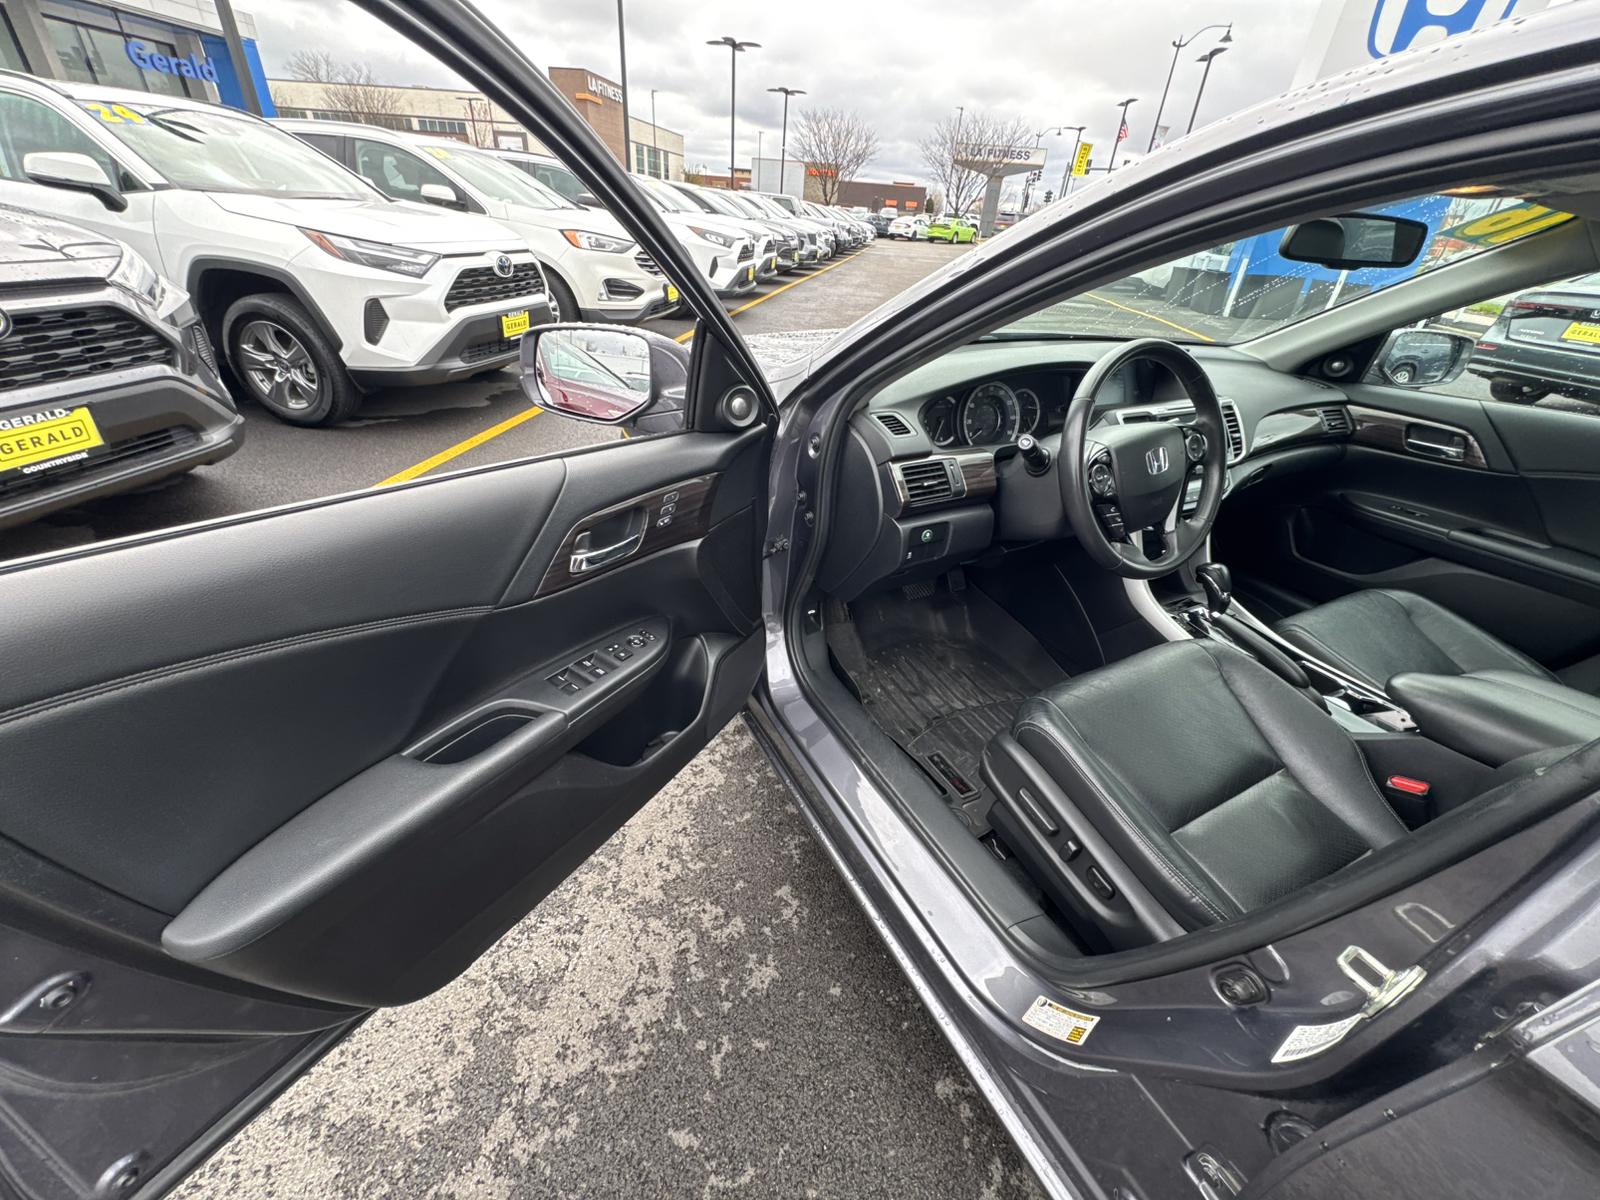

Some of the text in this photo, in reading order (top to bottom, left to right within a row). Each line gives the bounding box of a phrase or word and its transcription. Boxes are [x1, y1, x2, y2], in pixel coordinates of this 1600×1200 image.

[125, 41, 220, 84] Gerald
[587, 75, 623, 104] LA FITNESS
[85, 103, 147, 125] 24
[988, 149, 1031, 161] FITNESS
[1076, 146, 1088, 173] GERALD
[506, 319, 527, 330] GERALD
[0, 408, 67, 431] GERALD
[0, 426, 84, 455] GERALD
[23, 452, 89, 474] COUNTRYSIDE
